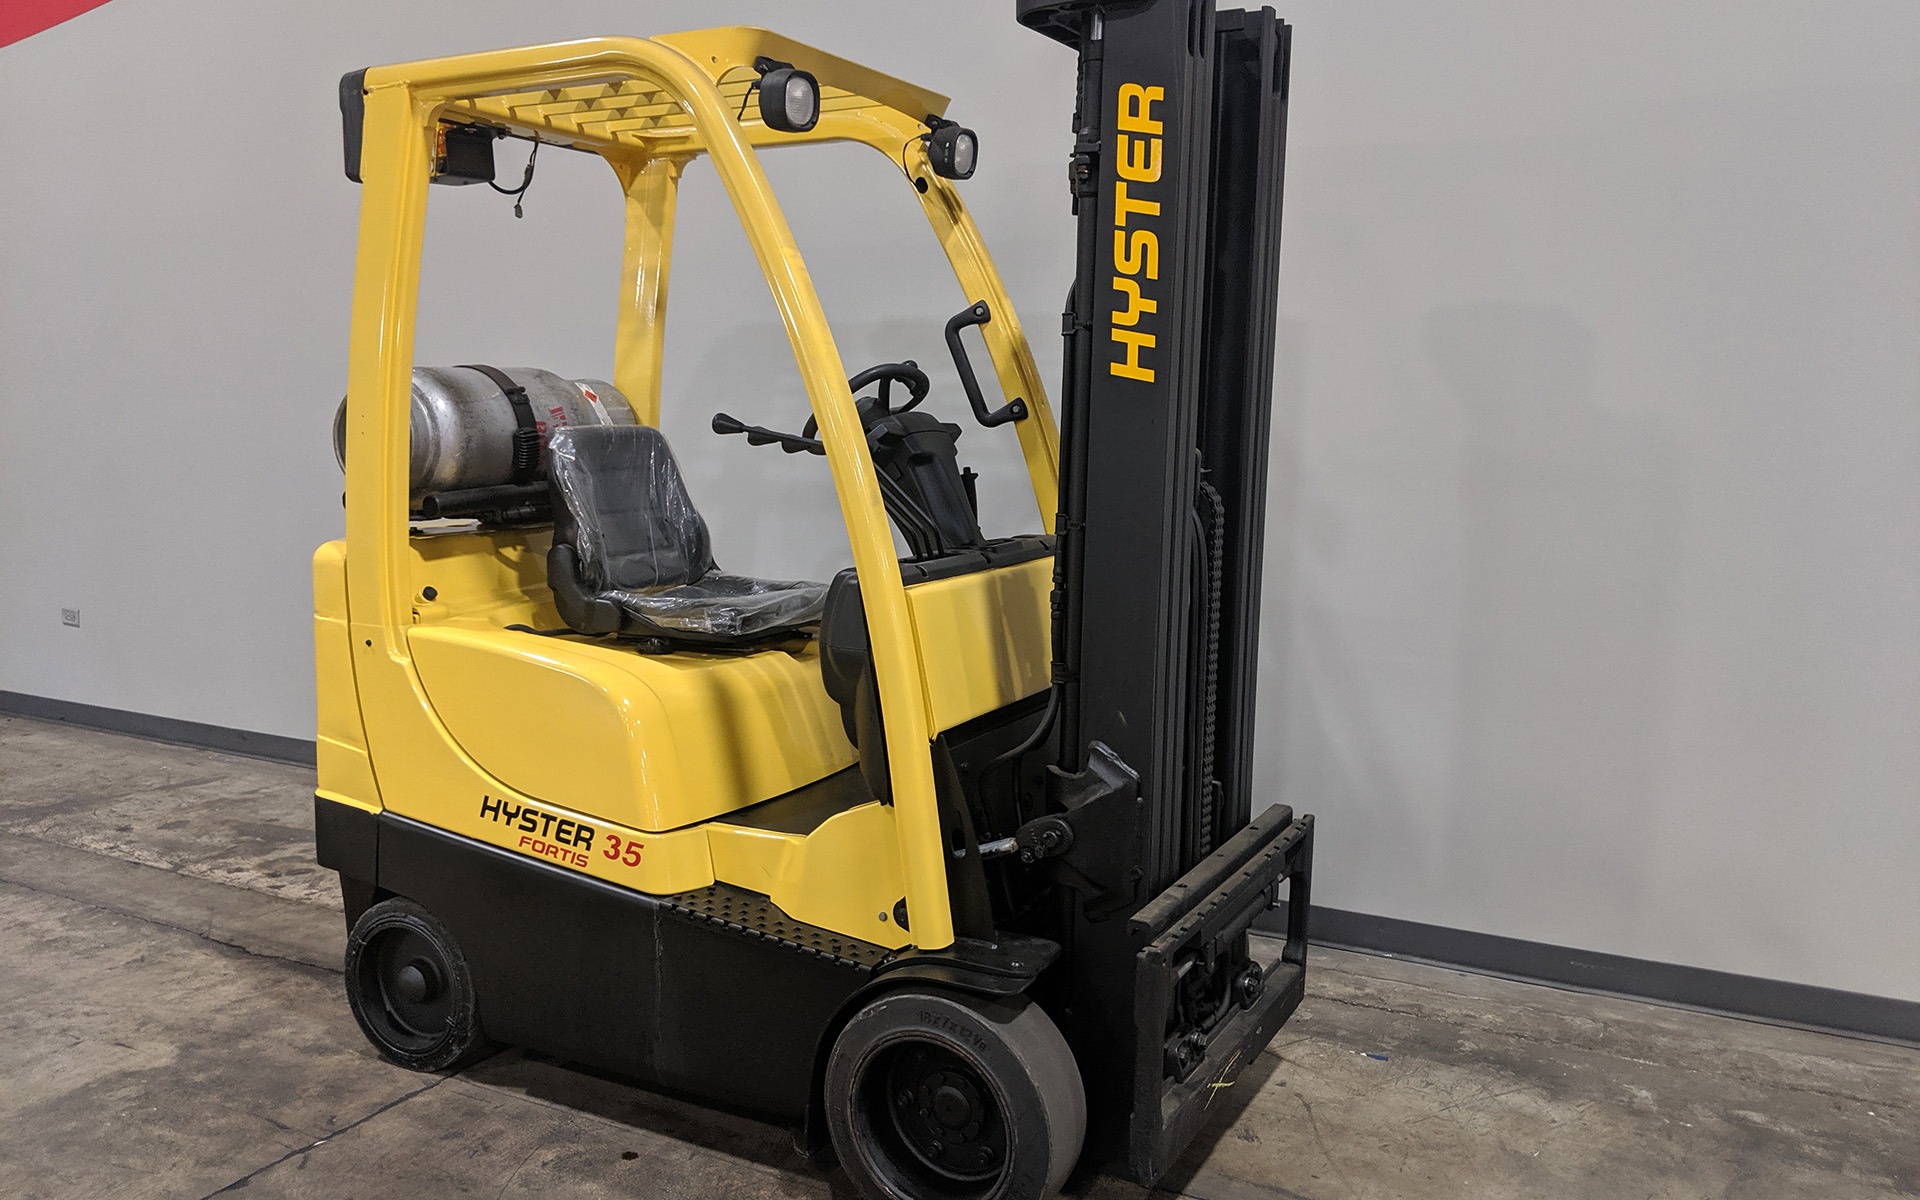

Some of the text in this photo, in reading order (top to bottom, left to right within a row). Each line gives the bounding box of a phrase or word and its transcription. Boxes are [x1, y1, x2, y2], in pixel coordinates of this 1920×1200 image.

[1110, 82, 1164, 383] HYSTER
[480, 795, 645, 867] HYSTER 35
[518, 835, 589, 868] FORTIS
